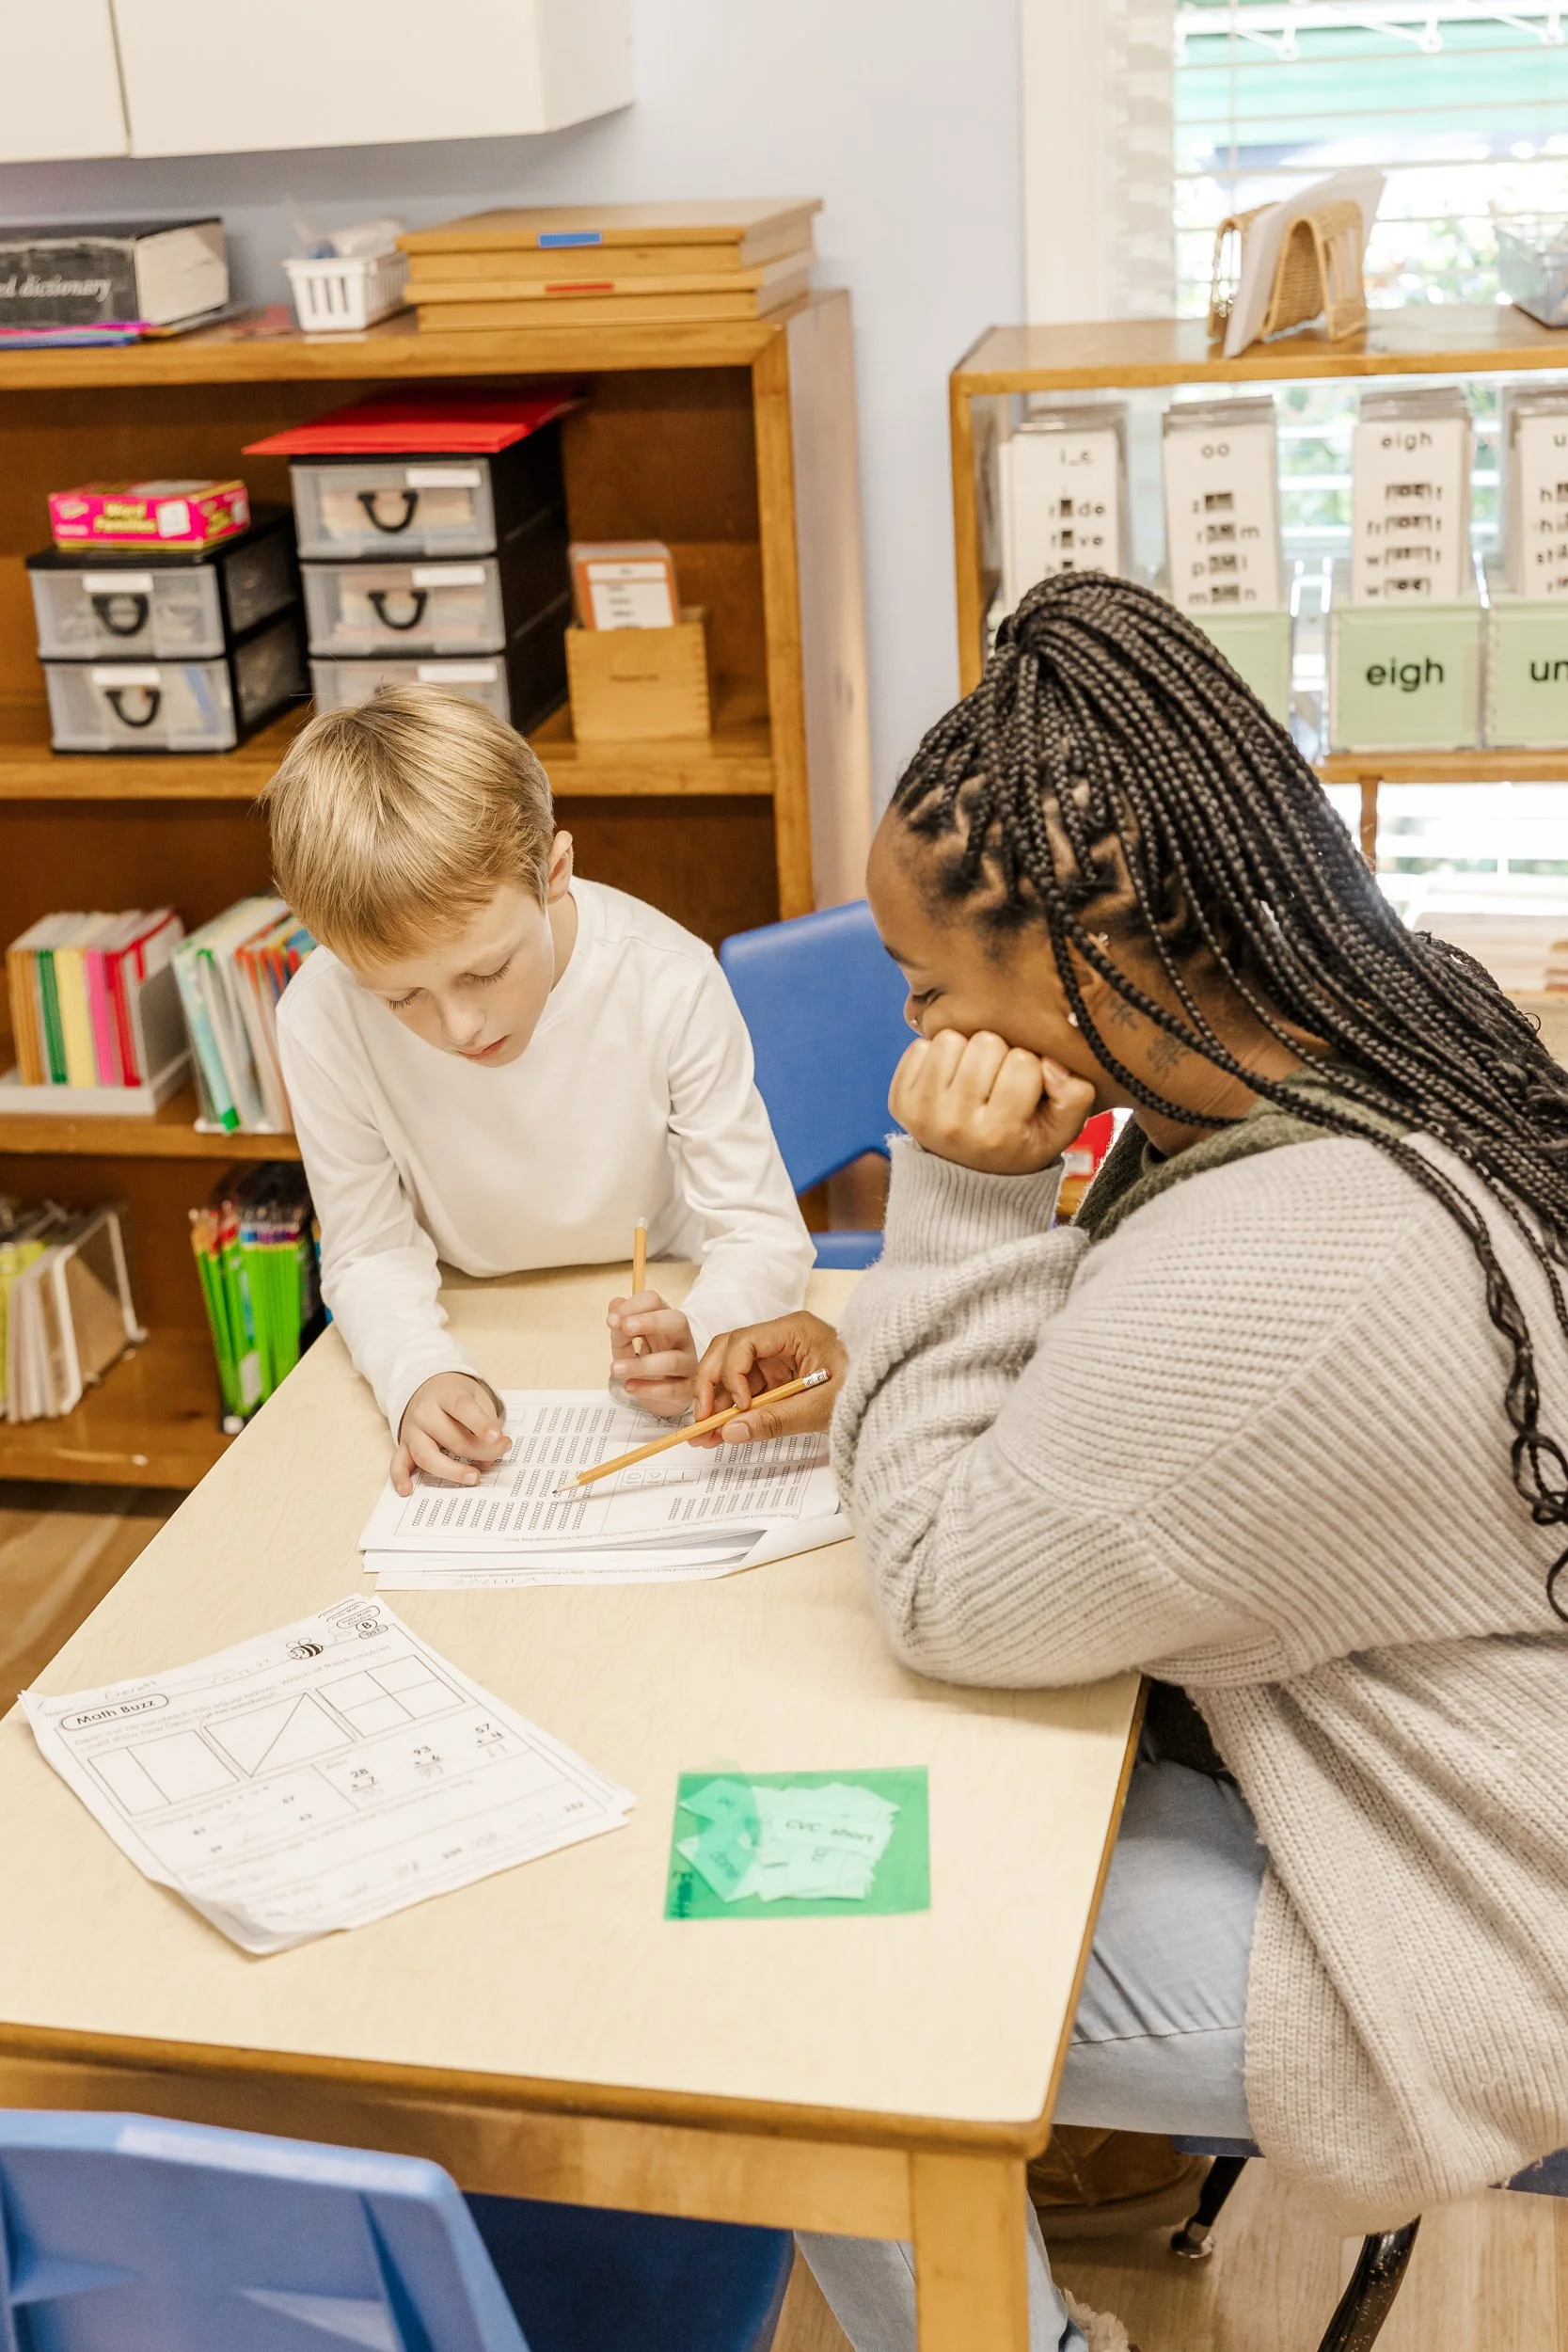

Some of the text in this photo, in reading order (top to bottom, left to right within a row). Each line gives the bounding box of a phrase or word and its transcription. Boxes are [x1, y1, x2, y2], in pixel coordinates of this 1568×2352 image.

[19, 273, 111, 303] dictionary
[1201, 442, 1230, 459] oo
[1381, 432, 1433, 453] eigh
[1366, 655, 1445, 692] eigh
[76, 1700, 156, 1724] Math Buzz
[785, 1819, 822, 1834] CVC
